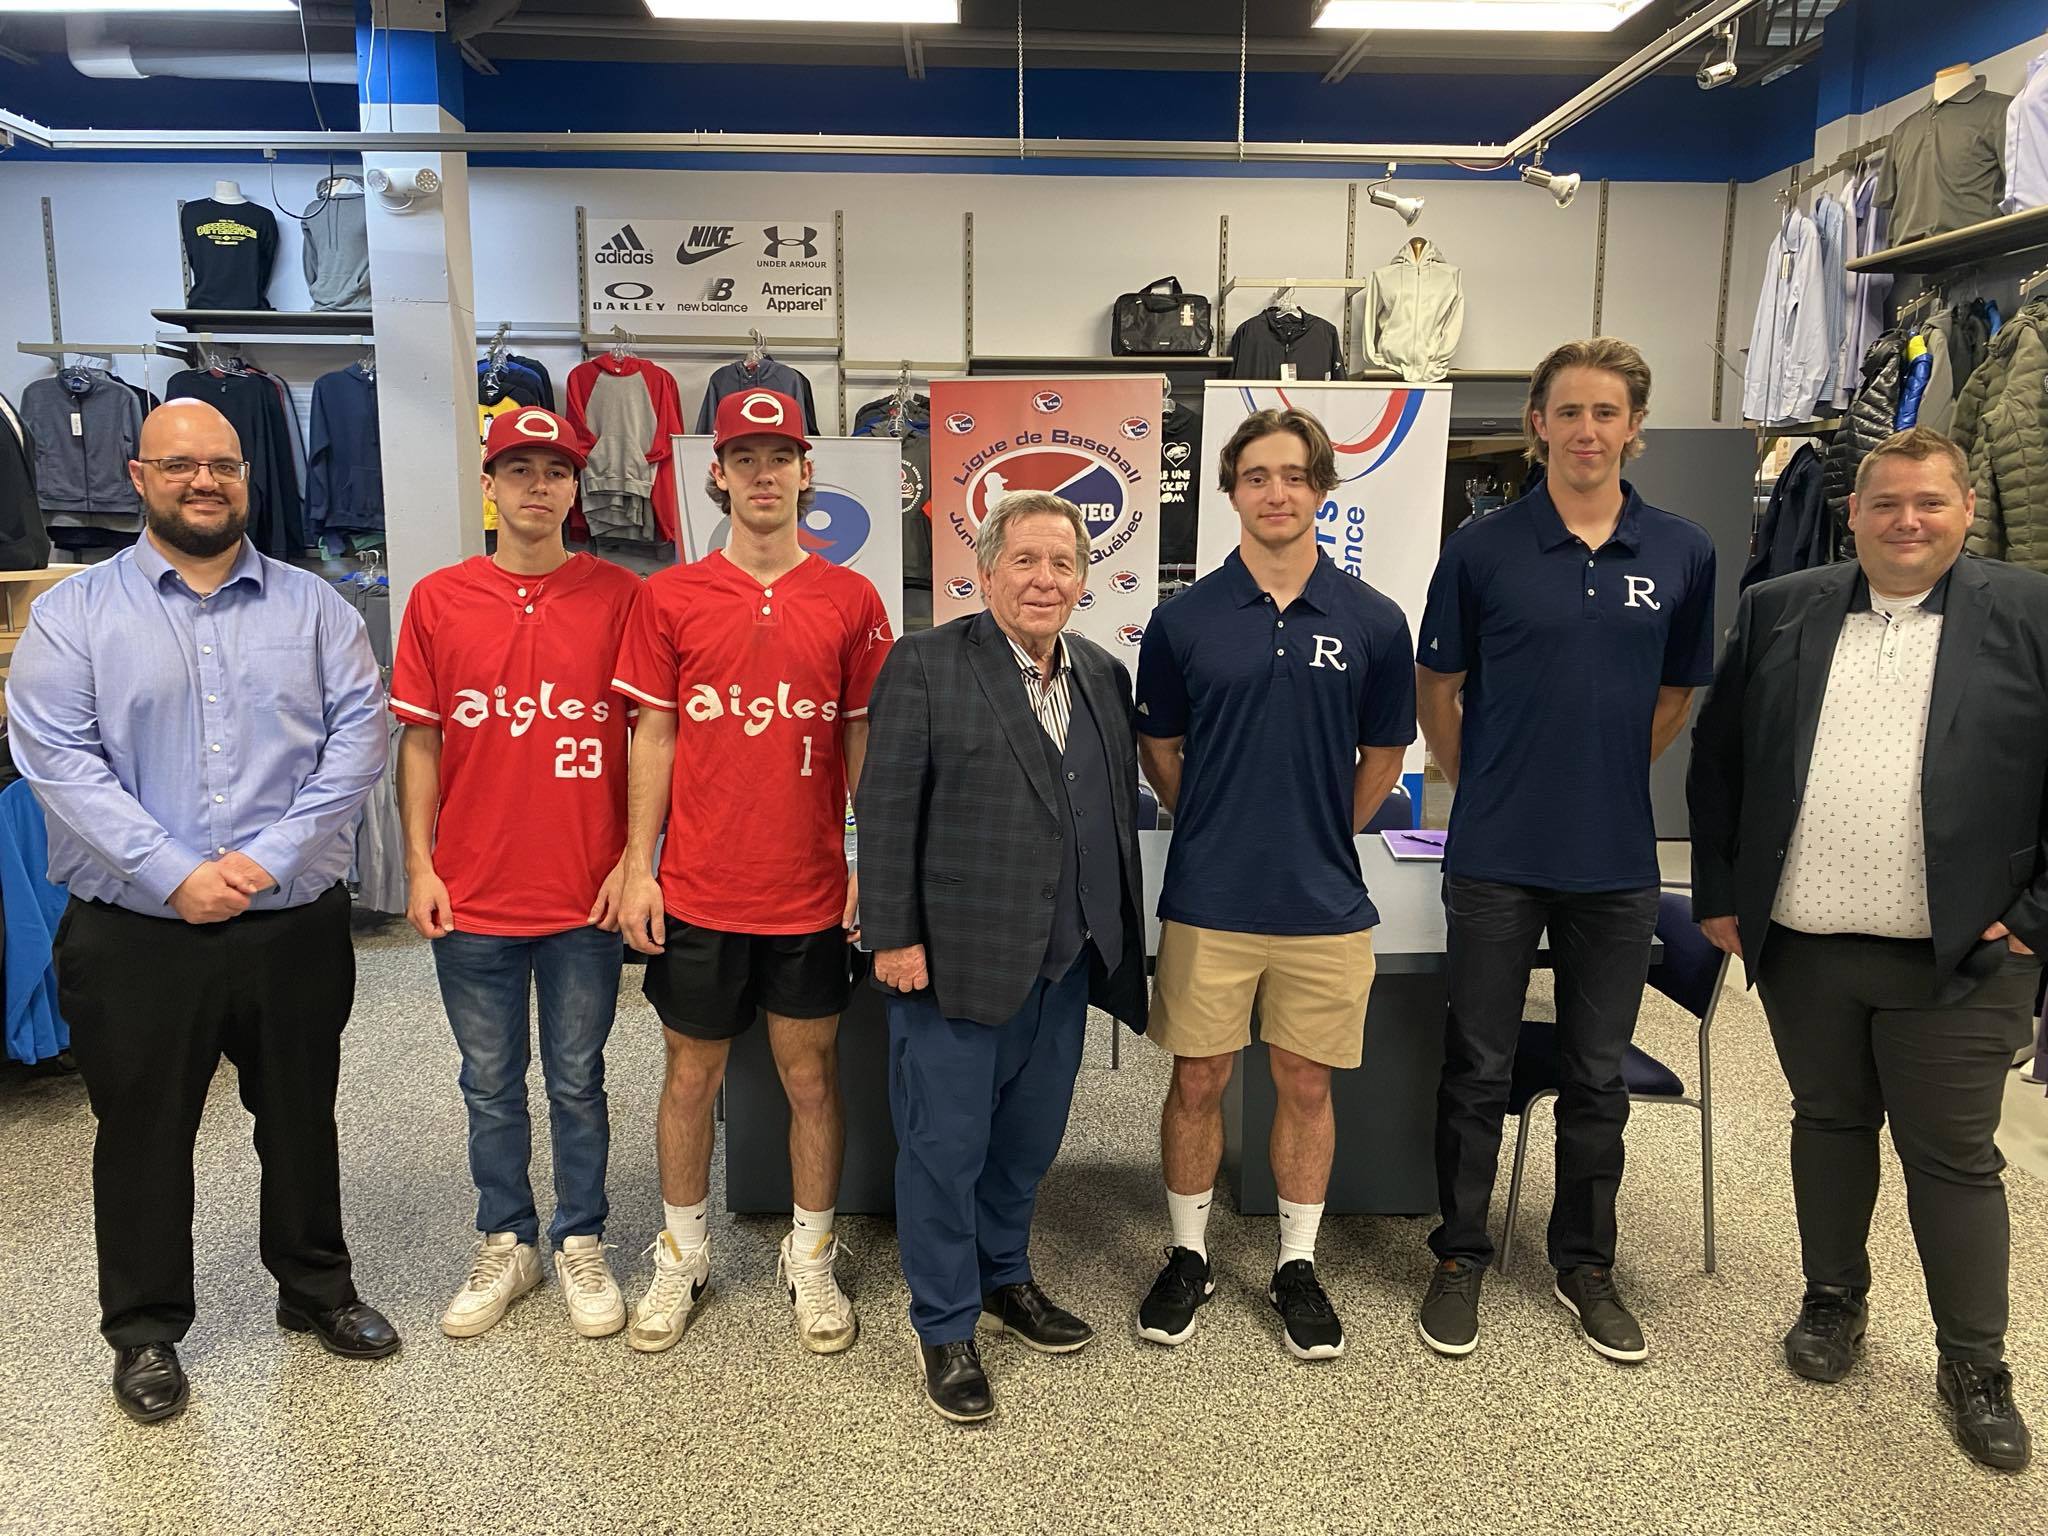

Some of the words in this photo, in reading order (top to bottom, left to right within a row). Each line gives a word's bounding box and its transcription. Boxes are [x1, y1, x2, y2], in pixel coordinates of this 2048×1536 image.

[687, 225, 734, 248] NIKE
[594, 249, 654, 265] adidas
[756, 260, 787, 268] UNDER
[789, 261, 827, 269] ARMOUR
[761, 282, 832, 297] American
[593, 301, 665, 311] OAKLEY
[677, 303, 701, 312] new
[702, 302, 748, 313] balance
[766, 297, 824, 313] Apparel
[953, 440, 1008, 486] Ligue
[1016, 430, 1043, 445] de
[1051, 429, 1142, 484] Baseball
[1171, 469, 1191, 480] UNE
[1160, 481, 1190, 492] CKEY
[1079, 503, 1116, 521] JEQ
[1315, 500, 1339, 545] TS
[949, 511, 977, 549] Juni
[1089, 510, 1143, 565] Québec
[1343, 506, 1365, 579] ence
[1624, 575, 1661, 611] R
[1309, 634, 1347, 671] R
[554, 736, 603, 779] 23
[800, 736, 813, 777] 1
